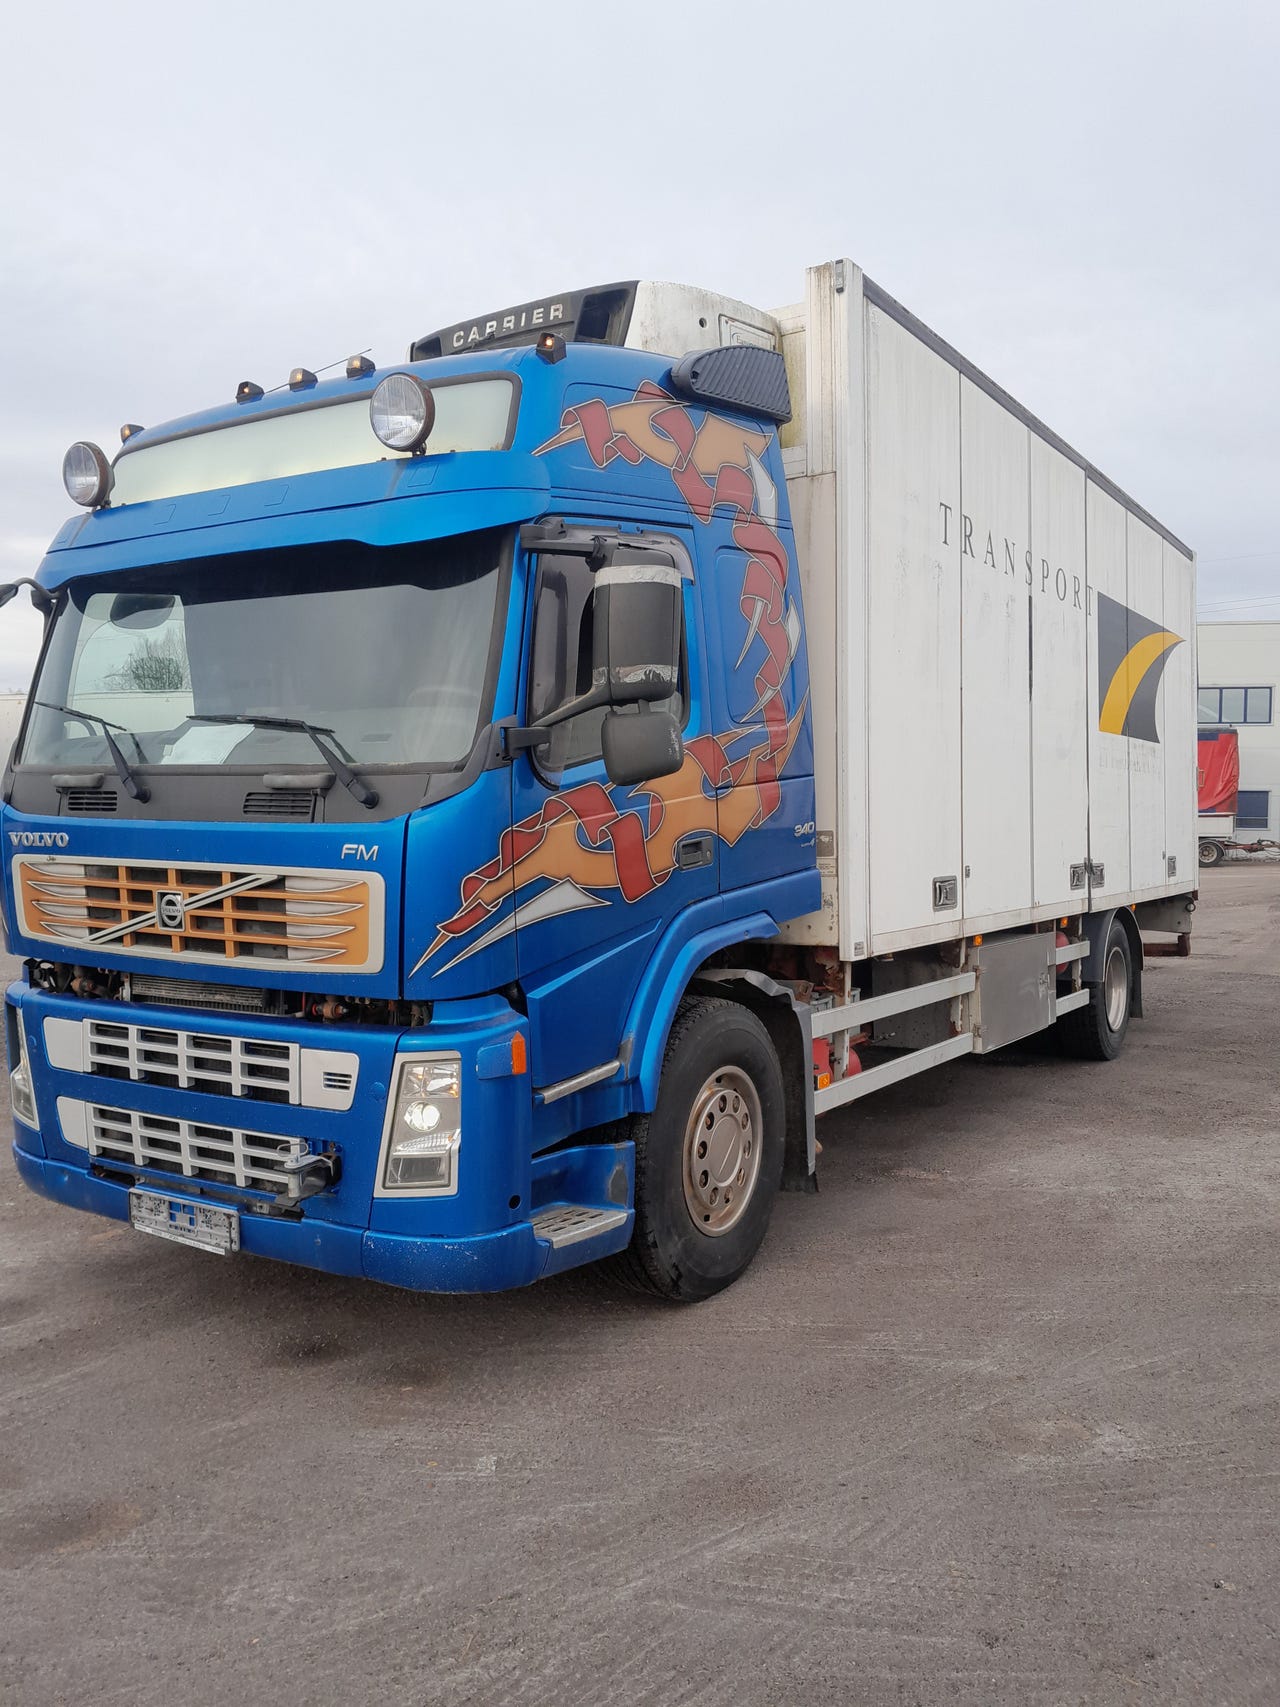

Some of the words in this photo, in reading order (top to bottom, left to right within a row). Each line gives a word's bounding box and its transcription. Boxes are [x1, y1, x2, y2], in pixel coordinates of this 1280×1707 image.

[453, 303, 563, 348] CARRIER
[939, 501, 1094, 617] TRANSPORT
[8, 831, 69, 848] VOLVO
[341, 843, 379, 861] FM
